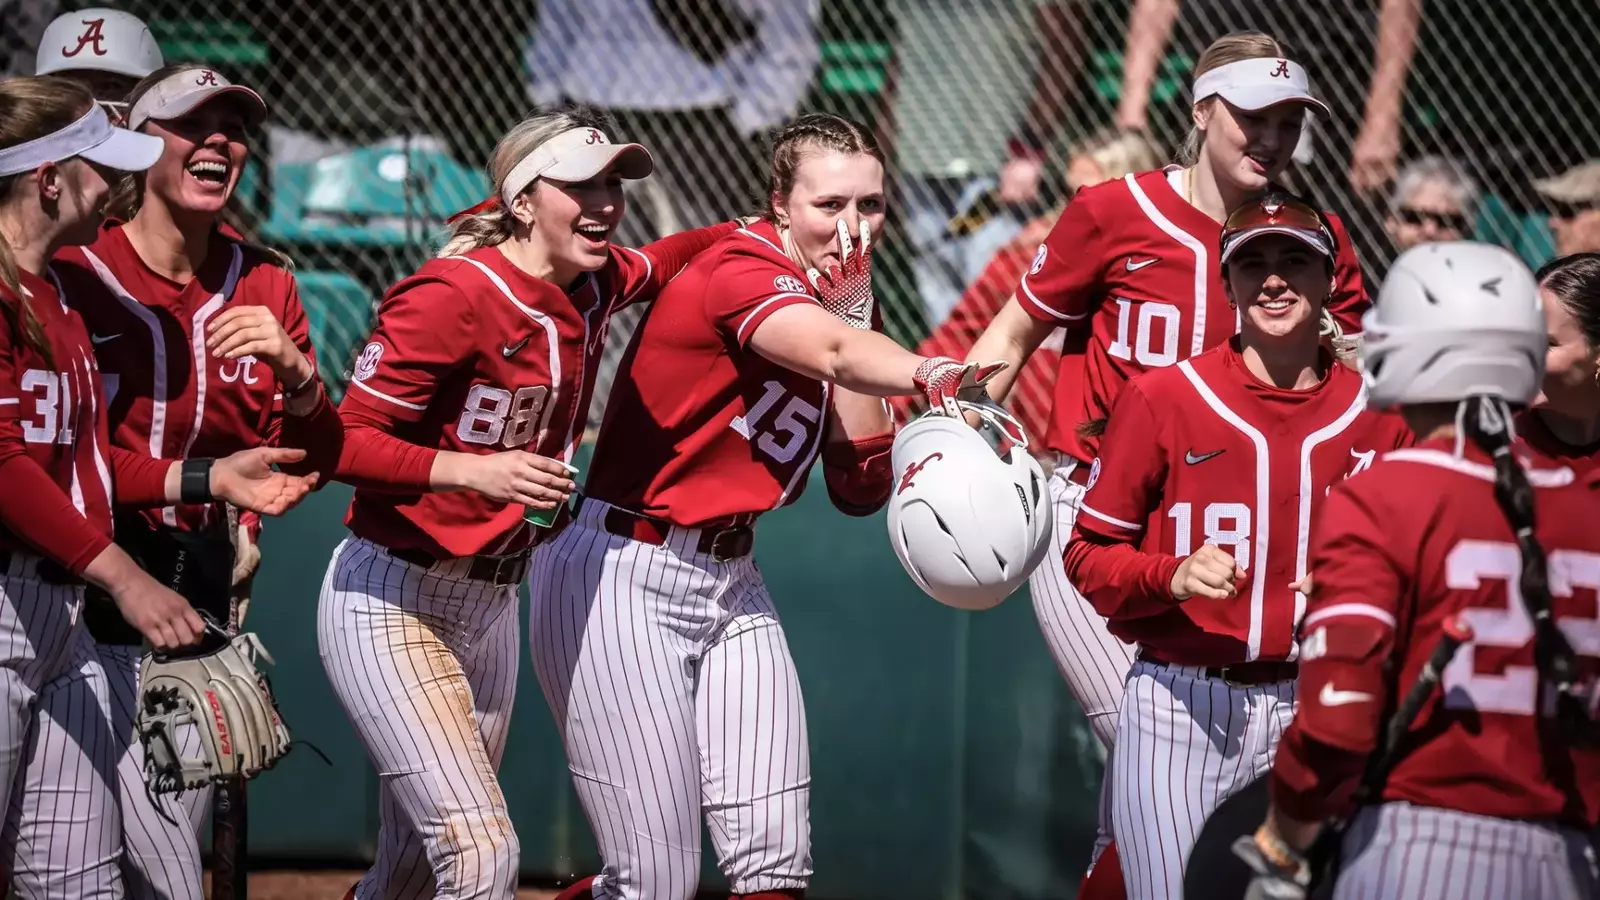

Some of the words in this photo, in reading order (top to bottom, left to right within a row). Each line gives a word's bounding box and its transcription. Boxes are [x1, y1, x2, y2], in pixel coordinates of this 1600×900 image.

[62, 18, 107, 58] A
[195, 70, 218, 86] A
[1270, 60, 1290, 78] A
[585, 129, 604, 144] A
[776, 276, 804, 293] SEC
[1107, 297, 1181, 367] 10
[20, 368, 72, 444] 31
[456, 384, 549, 448] 88
[729, 380, 821, 464] 15
[1168, 503, 1250, 571] 18
[171, 550, 186, 592] ENOM
[205, 689, 231, 756] EASTON
